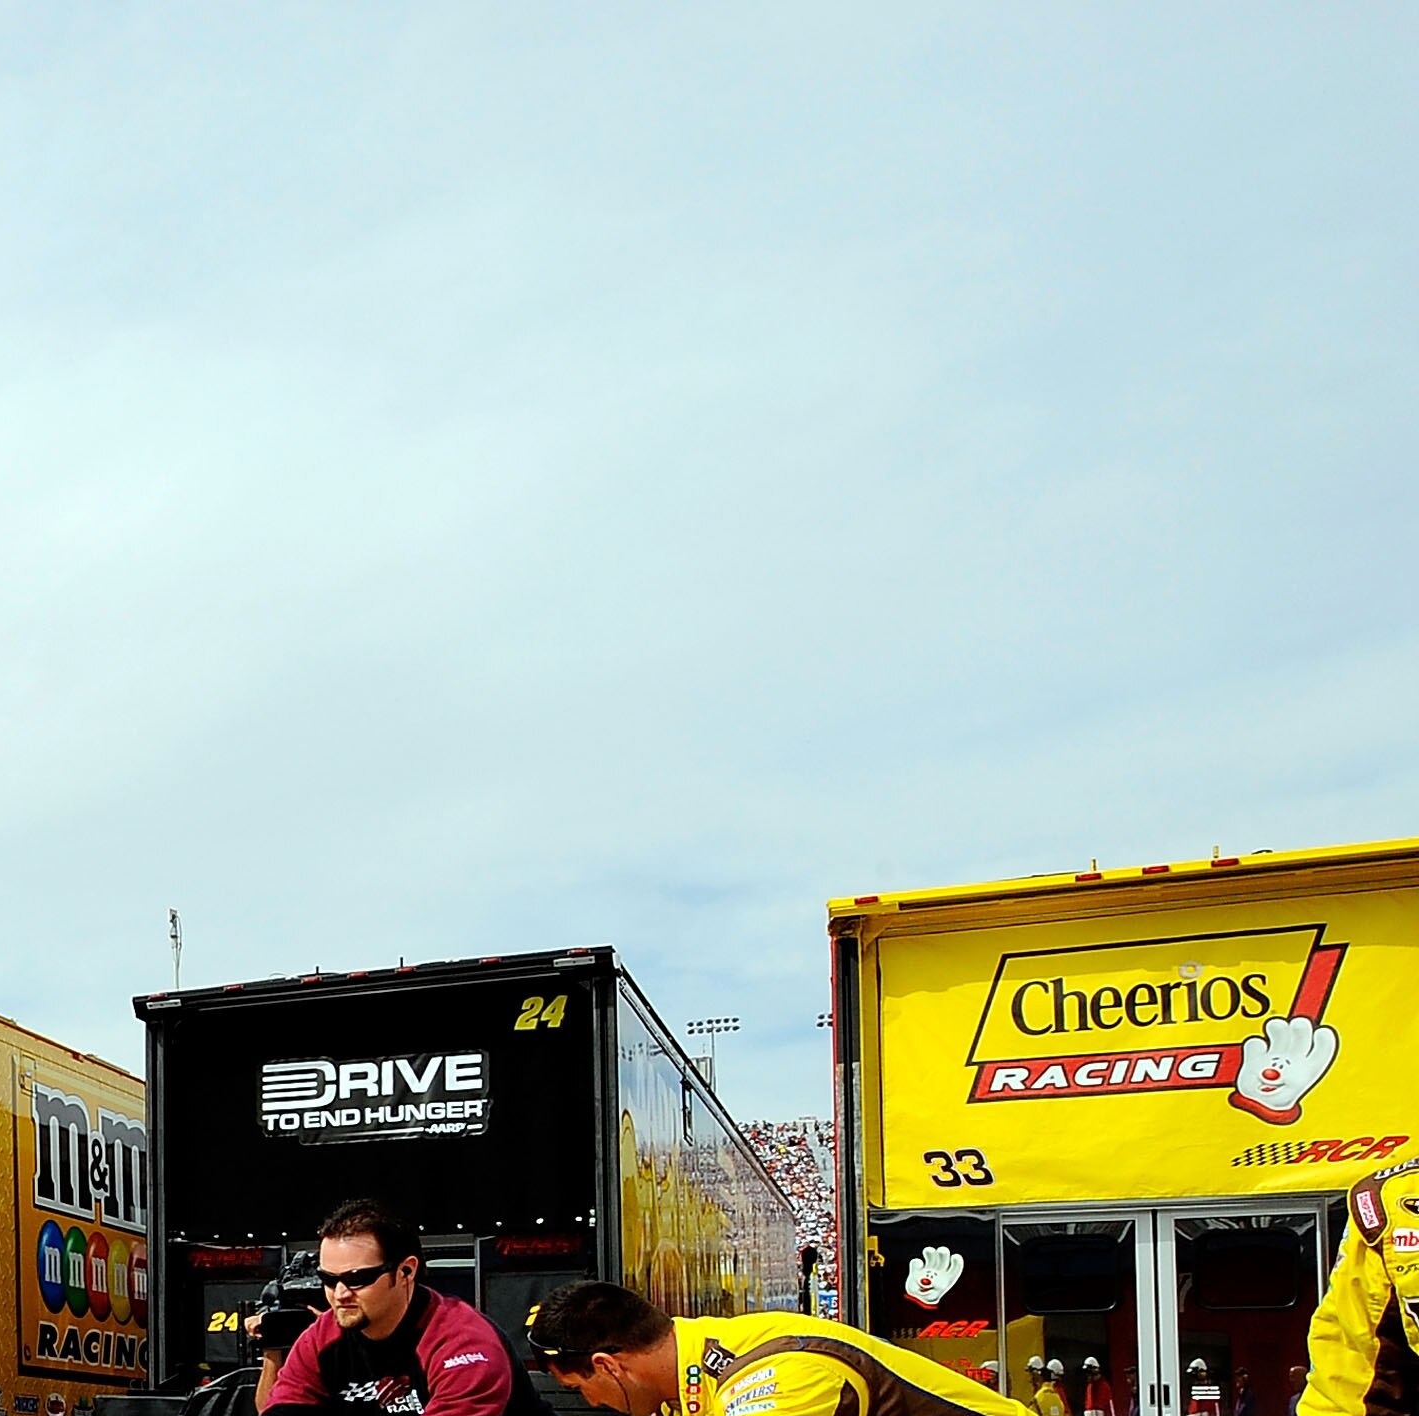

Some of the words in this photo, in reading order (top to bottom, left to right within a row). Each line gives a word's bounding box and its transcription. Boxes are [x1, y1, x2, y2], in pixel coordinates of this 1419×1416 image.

[514, 995, 569, 1031] 24
[1011, 962, 1271, 1036] Cheerios
[262, 1053, 483, 1112] DRIVE
[989, 1052, 1221, 1093] RACING
[262, 1113, 300, 1131] TO
[303, 1108, 361, 1129] END
[364, 1100, 483, 1125] HUNGER
[922, 1148, 996, 1189] 33
[1291, 1134, 1411, 1165] RCR
[206, 1310, 239, 1332] 24
